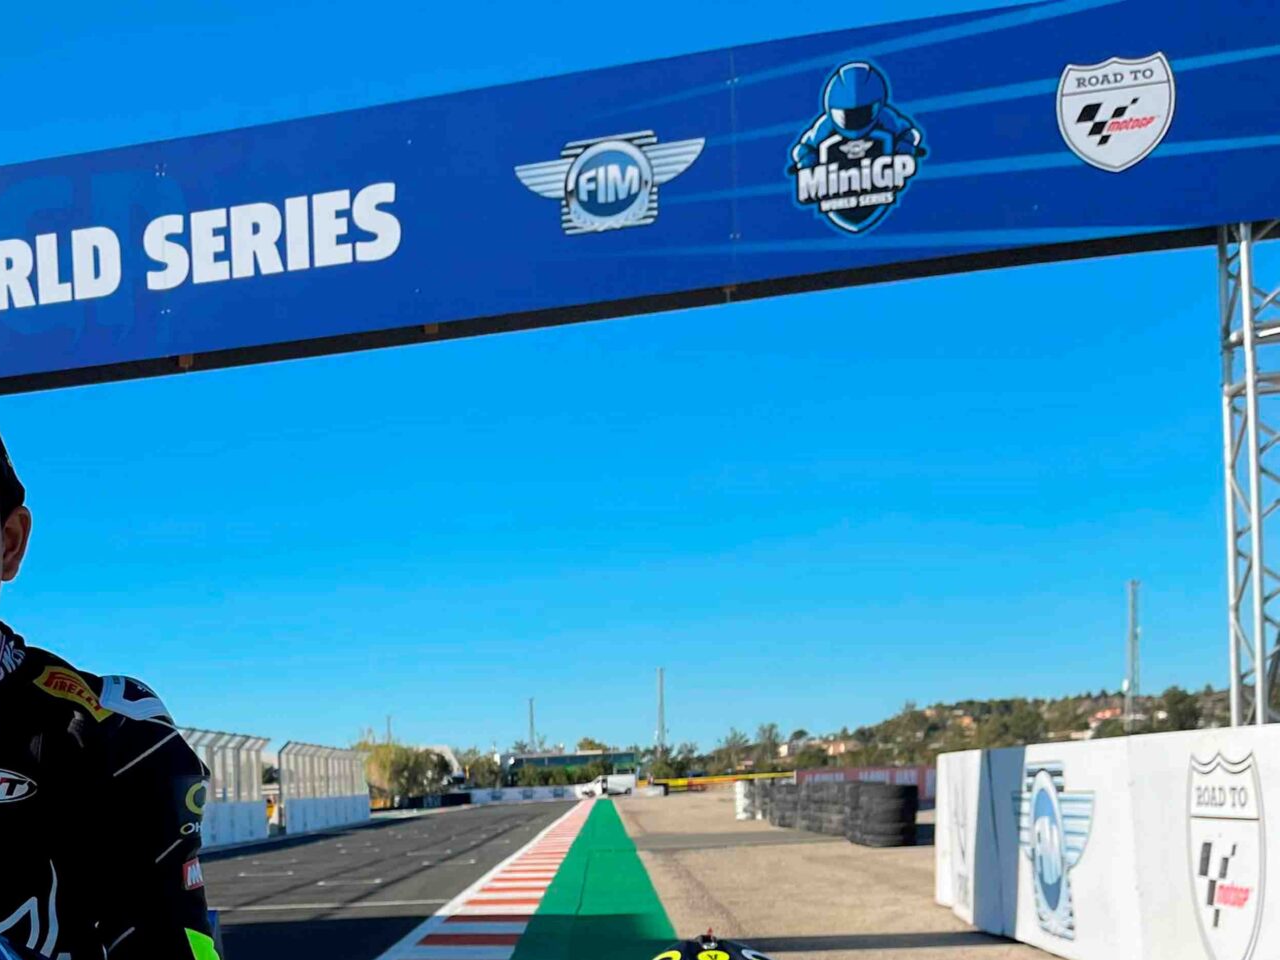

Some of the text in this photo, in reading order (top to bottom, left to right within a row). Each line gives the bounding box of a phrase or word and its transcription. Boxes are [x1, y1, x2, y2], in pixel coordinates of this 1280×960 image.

[1075, 67, 1154, 88] ROAD TO
[578, 164, 640, 203] FIM
[797, 154, 916, 202] MiniGP
[142, 181, 402, 291] SERIES
[44, 671, 102, 712] PIRELLI
[1229, 784, 1249, 808] TO
